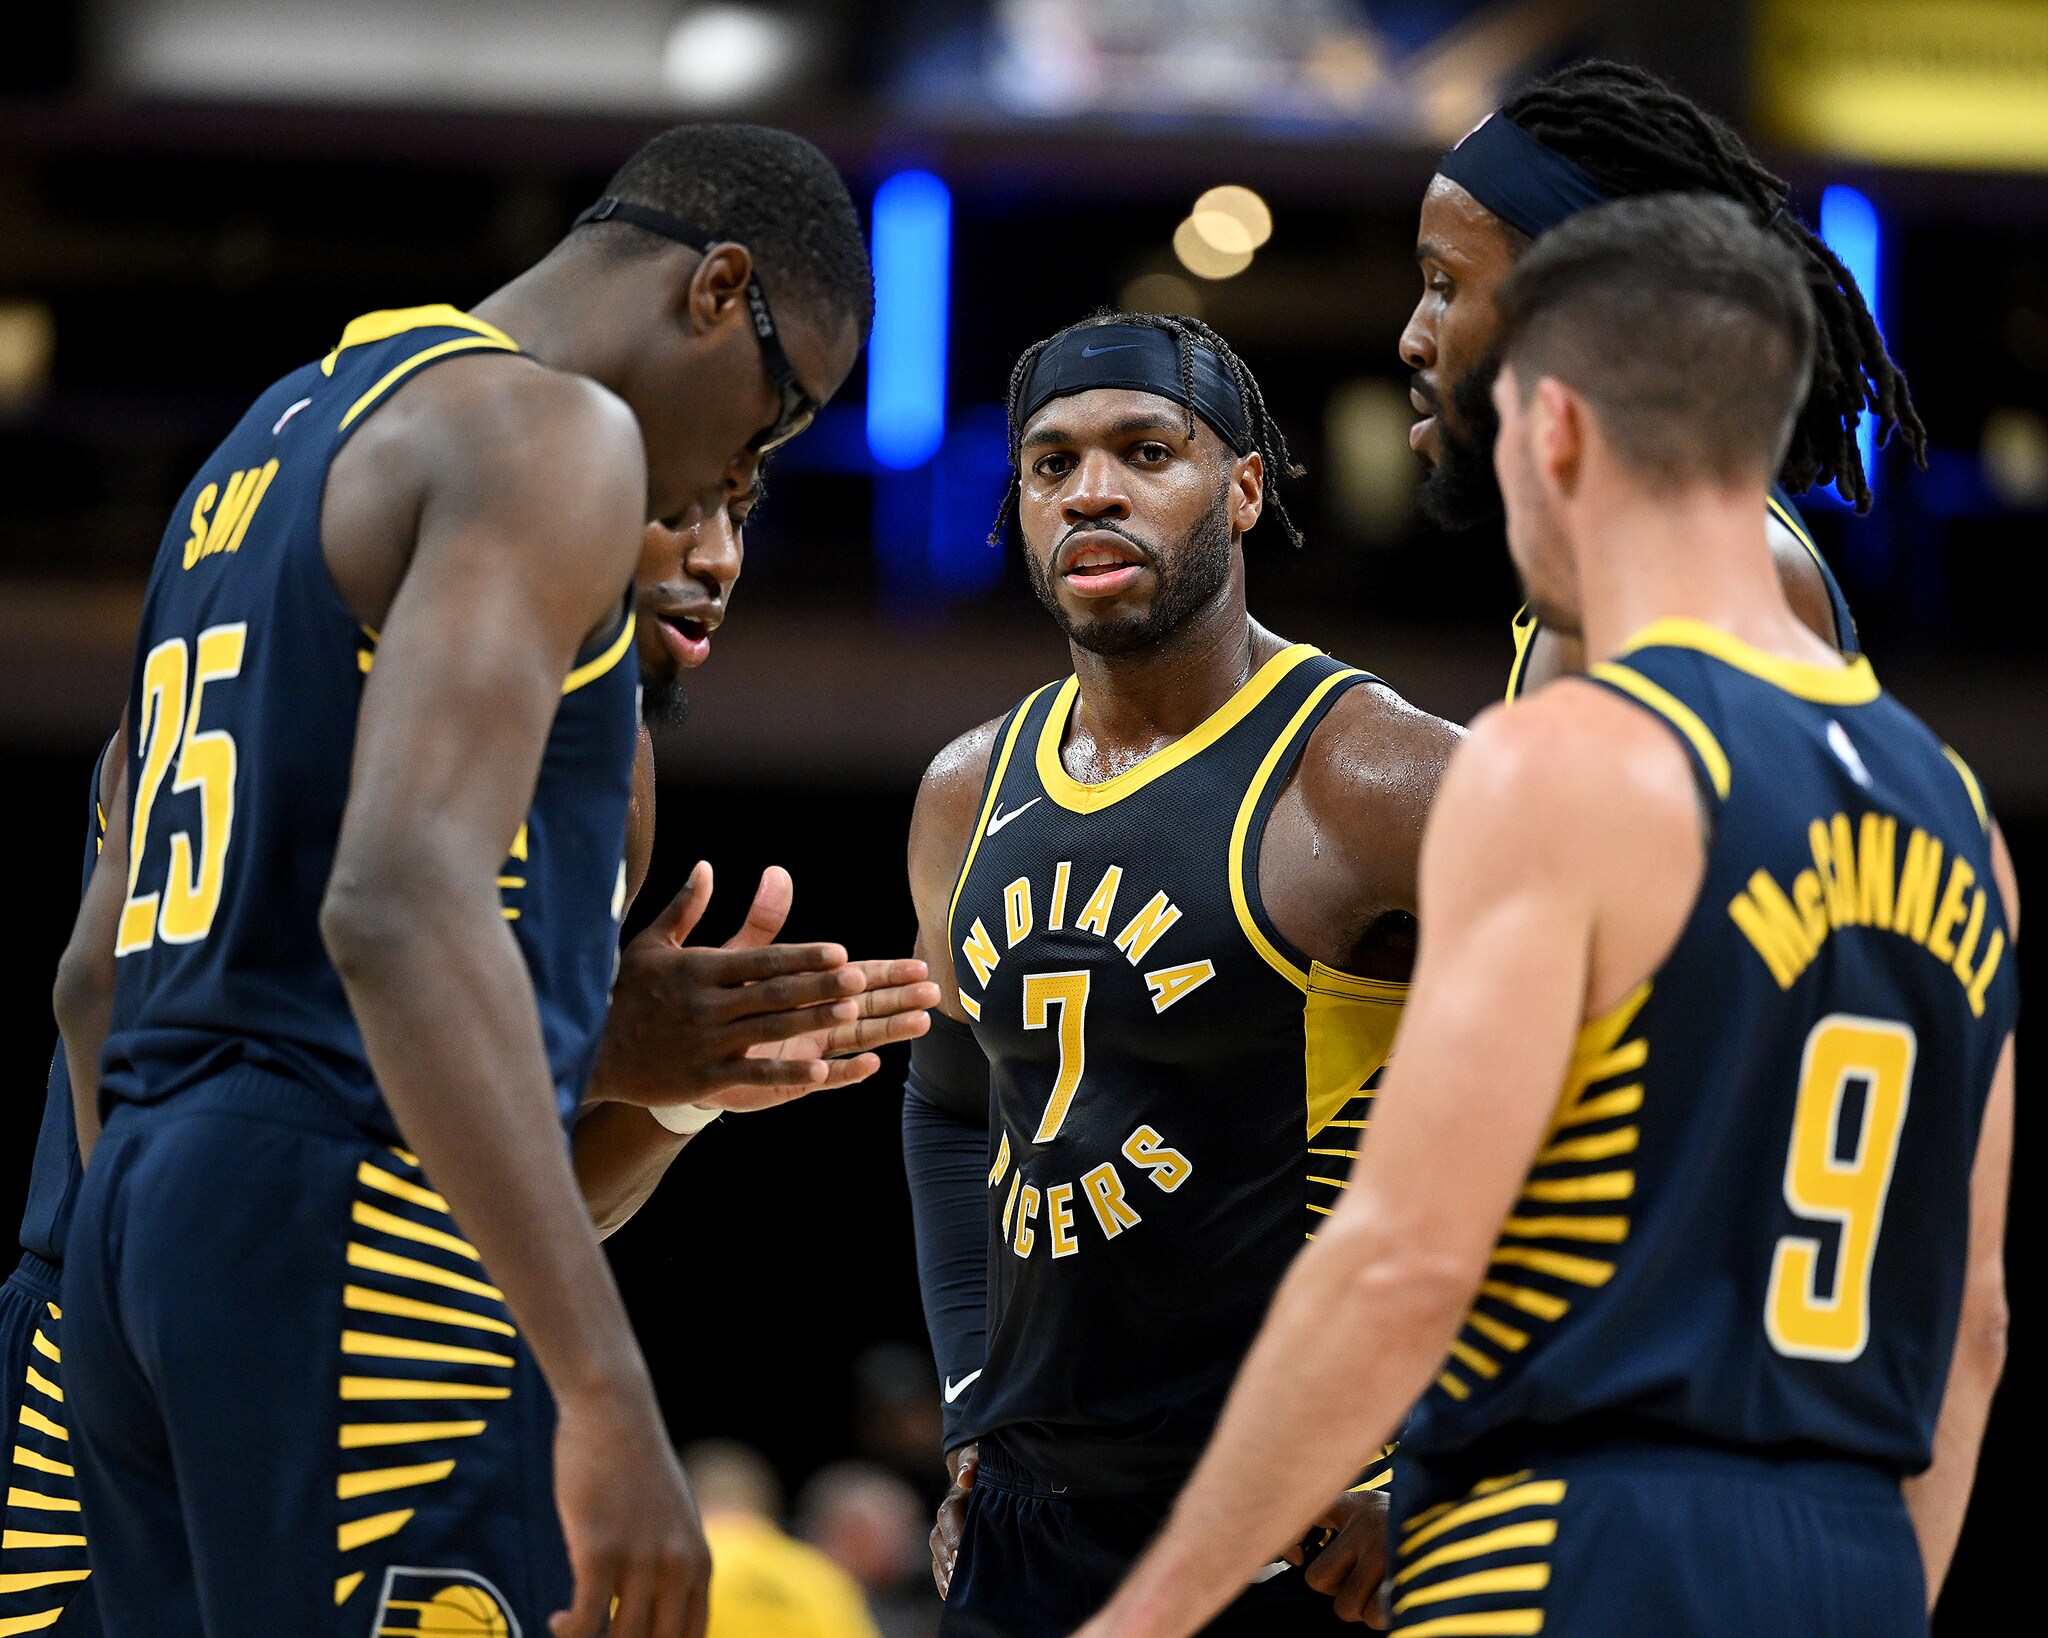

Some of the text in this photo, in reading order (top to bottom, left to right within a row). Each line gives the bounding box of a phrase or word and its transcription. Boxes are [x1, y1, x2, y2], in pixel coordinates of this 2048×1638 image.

[115, 622, 247, 957] 25
[959, 861, 1216, 1022] INDIANA
[1023, 970, 1090, 1143] 7
[1765, 1013, 1917, 1362] 9
